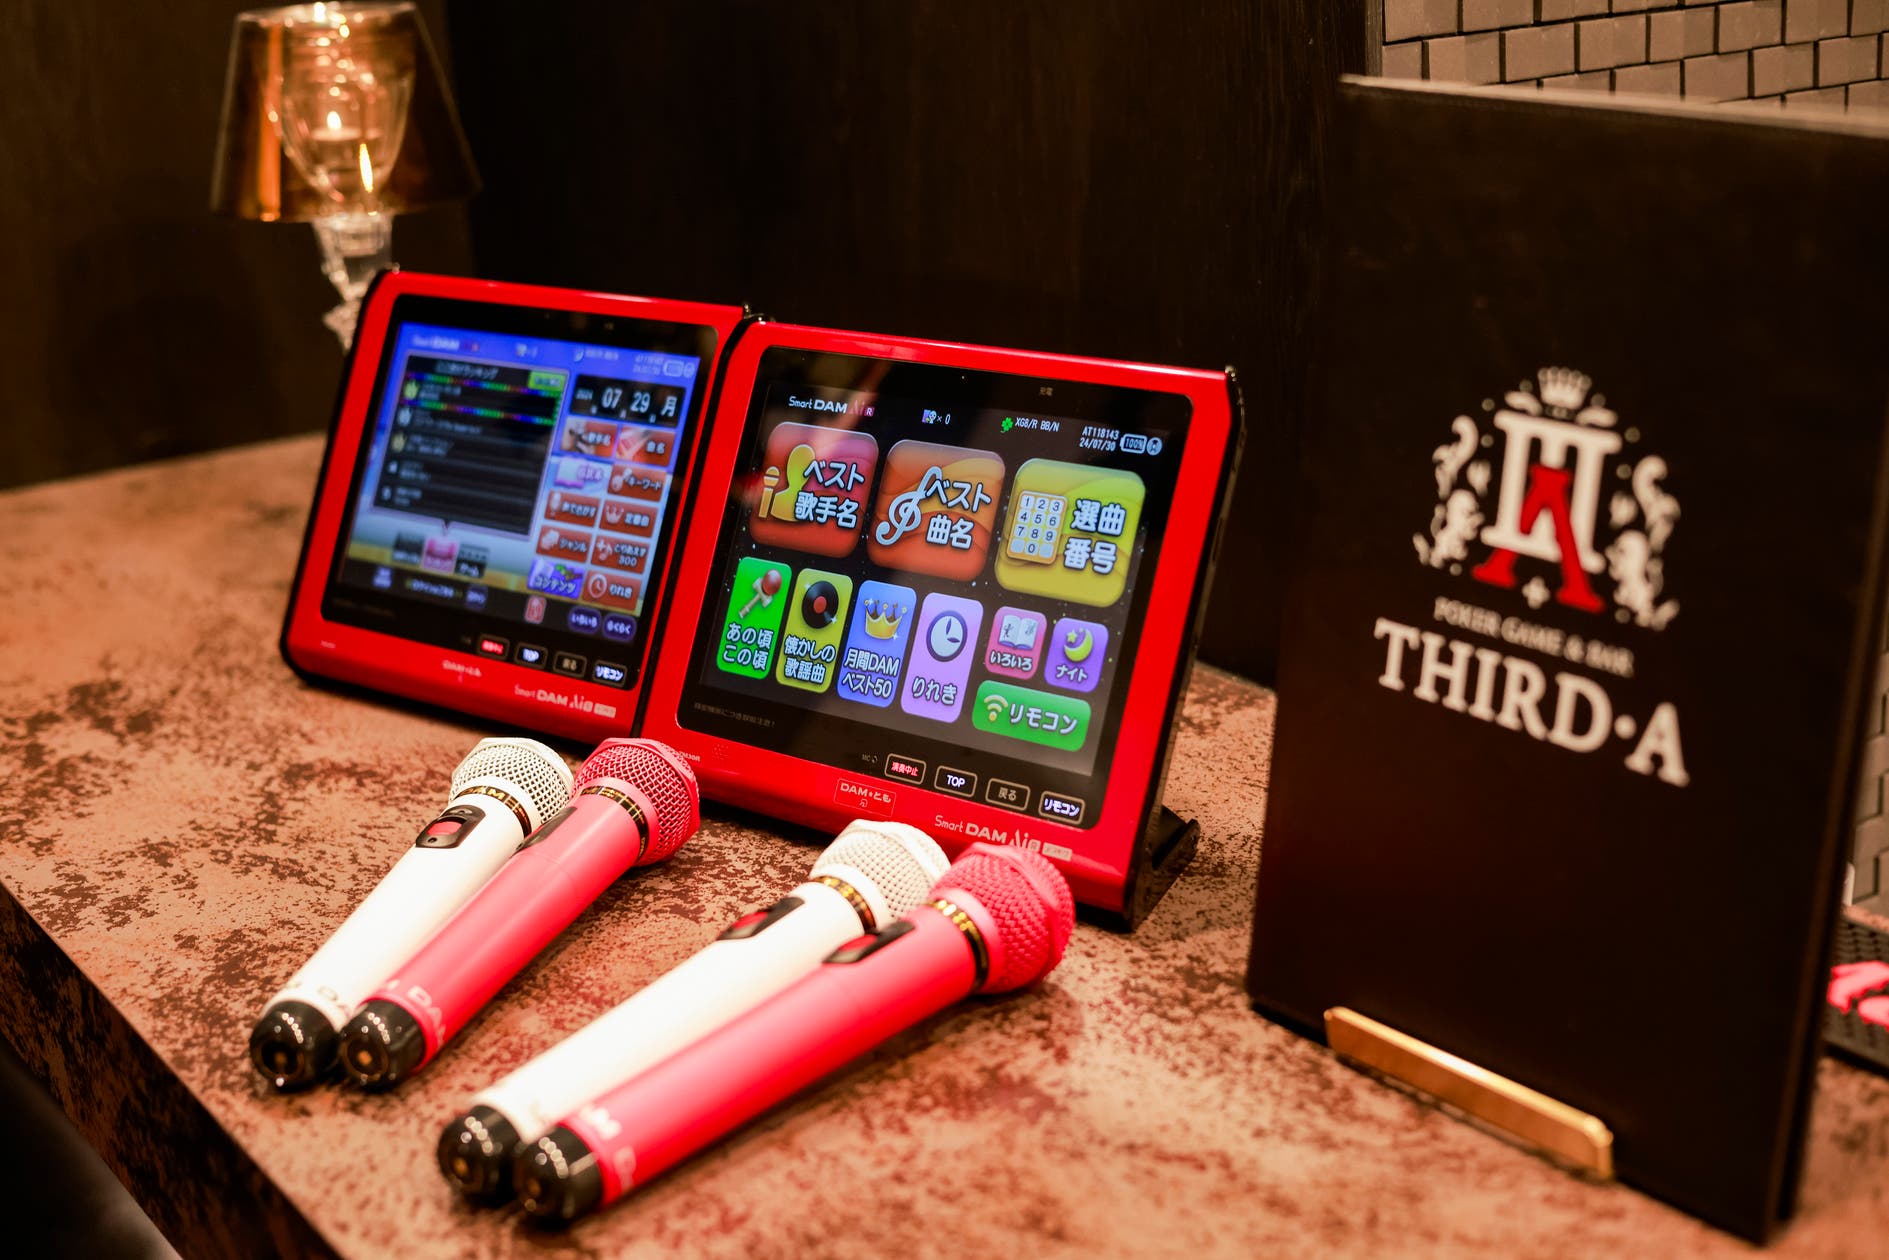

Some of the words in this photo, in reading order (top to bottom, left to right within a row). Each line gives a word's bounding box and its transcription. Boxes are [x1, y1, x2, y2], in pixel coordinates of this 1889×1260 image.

[601, 387, 623, 409] 07
[630, 390, 651, 413] 29
[788, 395, 813, 410] Smart
[813, 399, 848, 414] DAM
[1079, 438, 1116, 452] 24/07/30
[1081, 425, 1120, 441] AT118143
[803, 459, 865, 492] ベスト
[926, 479, 992, 513] ベスト
[794, 491, 859, 529] 歌手名
[1070, 498, 1127, 537] 選曲
[926, 514, 975, 550] 曲名
[1064, 536, 1118, 575] 番号
[535, 575, 576, 593] コンテンツ
[726, 622, 774, 650] あの頃
[784, 635, 836, 663] 懐かしの
[522, 648, 541, 663] TOP
[722, 644, 770, 671] この頃
[844, 648, 900, 678] 月間DAM
[990, 650, 1033, 671] いろいろ
[595, 664, 625, 682] リモコン
[784, 658, 826, 685] 歌謡曲
[1055, 664, 1088, 684] ナイト
[536, 689, 569, 707] DAM
[842, 673, 893, 699] ベスト50
[912, 676, 958, 706] りれき
[1009, 702, 1078, 736] リモコン
[946, 774, 966, 789] TOP
[998, 787, 1018, 802] 戻る
[1044, 798, 1081, 818] リモコン
[934, 815, 963, 833] Smart
[965, 822, 1008, 844] DAM
